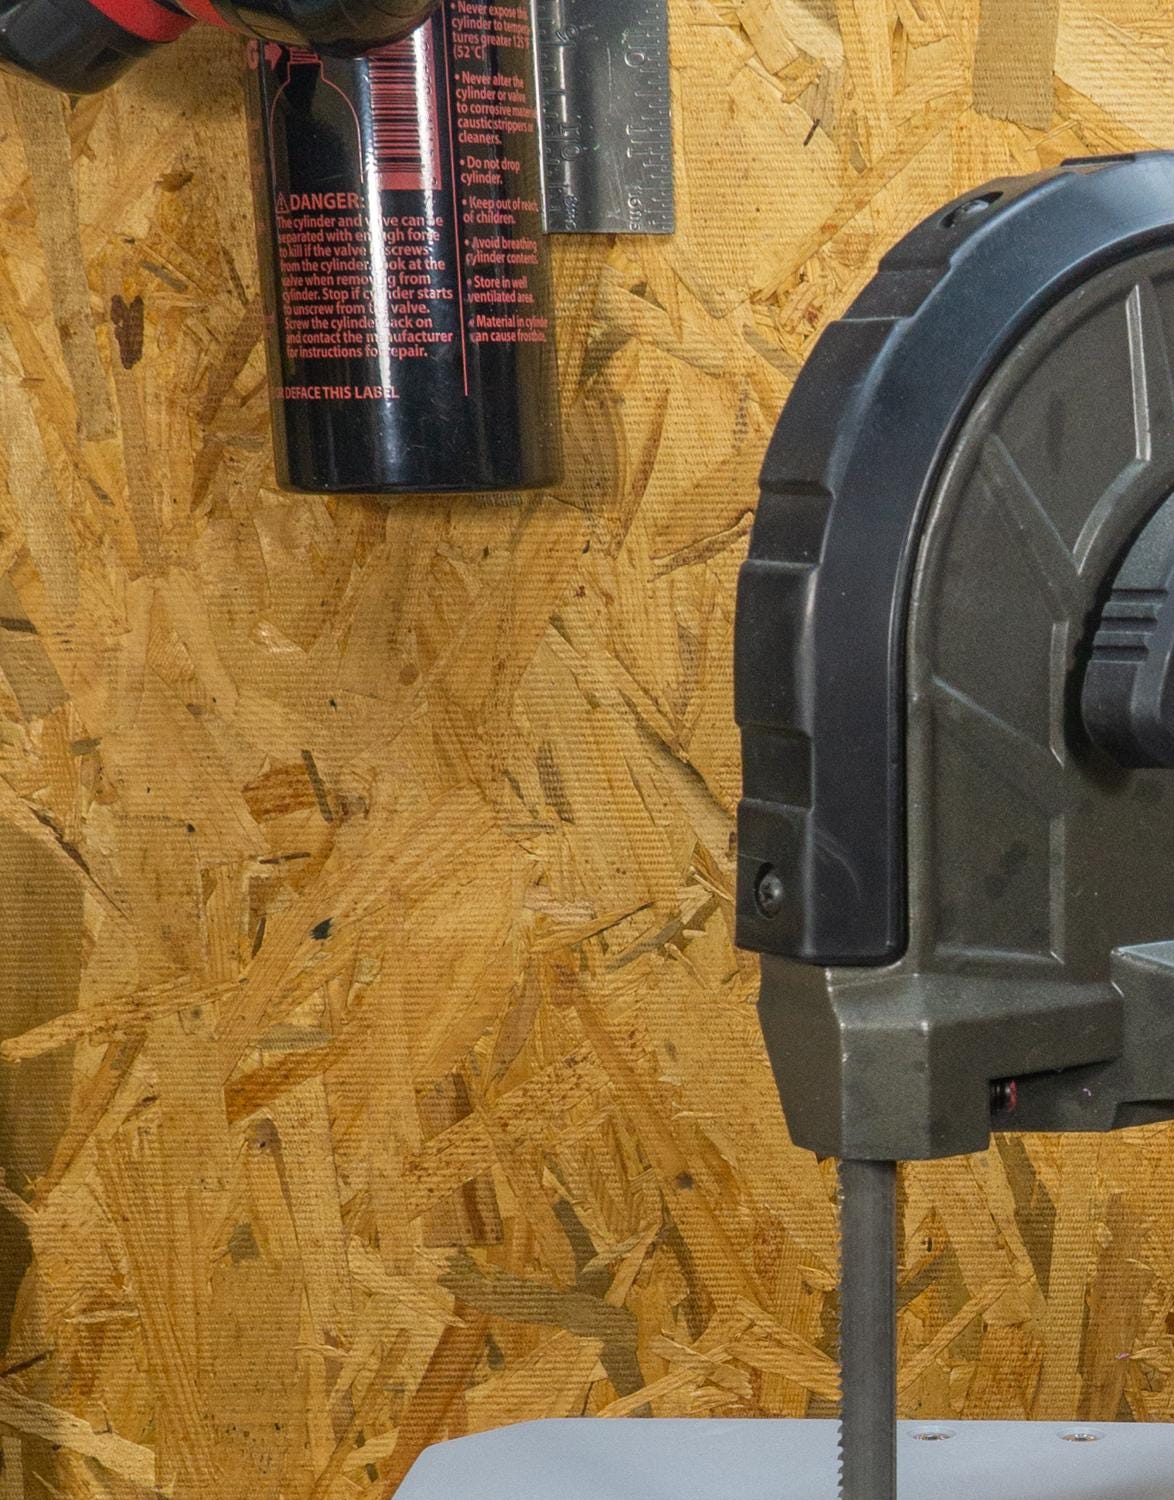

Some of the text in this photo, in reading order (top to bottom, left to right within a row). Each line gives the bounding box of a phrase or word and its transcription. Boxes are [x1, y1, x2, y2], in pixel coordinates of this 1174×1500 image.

[458, 1, 487, 14] Never
[452, 15, 502, 30] cylinder to
[453, 31, 511, 47] tures greater
[462, 71, 491, 85] Never
[492, 73, 511, 86] alter
[456, 85, 495, 101] cylinder
[456, 102, 511, 116] to corrosive
[458, 117, 494, 129] caustic
[458, 130, 502, 144] cleaners.
[467, 156, 520, 174] Do not drop
[461, 171, 502, 186] cylinder.
[290, 193, 365, 210] DANGER:
[469, 196, 521, 212] Keep out of
[294, 215, 335, 231] cylinder
[338, 214, 362, 226] and
[402, 217, 424, 226] can
[464, 211, 516, 223] of children.
[326, 229, 352, 241] with
[289, 244, 302, 257] kill
[304, 245, 311, 256] if
[313, 244, 332, 256] the
[335, 244, 366, 257] valve
[471, 236, 537, 253] Avoid breathing
[281, 257, 445, 273] from the cylinder. at the
[466, 251, 505, 266] cylinder
[305, 273, 334, 286] when
[399, 272, 430, 284] from
[474, 275, 500, 288] Store
[502, 275, 510, 288] in
[283, 287, 453, 304] cylinder. Stop if starts
[468, 290, 516, 303] ventilated
[293, 304, 334, 314] unscrew
[336, 301, 365, 314] from
[392, 301, 430, 314] valve.
[285, 317, 432, 329] Screw the on
[476, 315, 524, 327] Material in
[287, 331, 362, 344] and contact the
[470, 332, 516, 342] can cause
[288, 346, 363, 358] for instructions
[285, 386, 399, 399] DEFACE THIS LABEL
